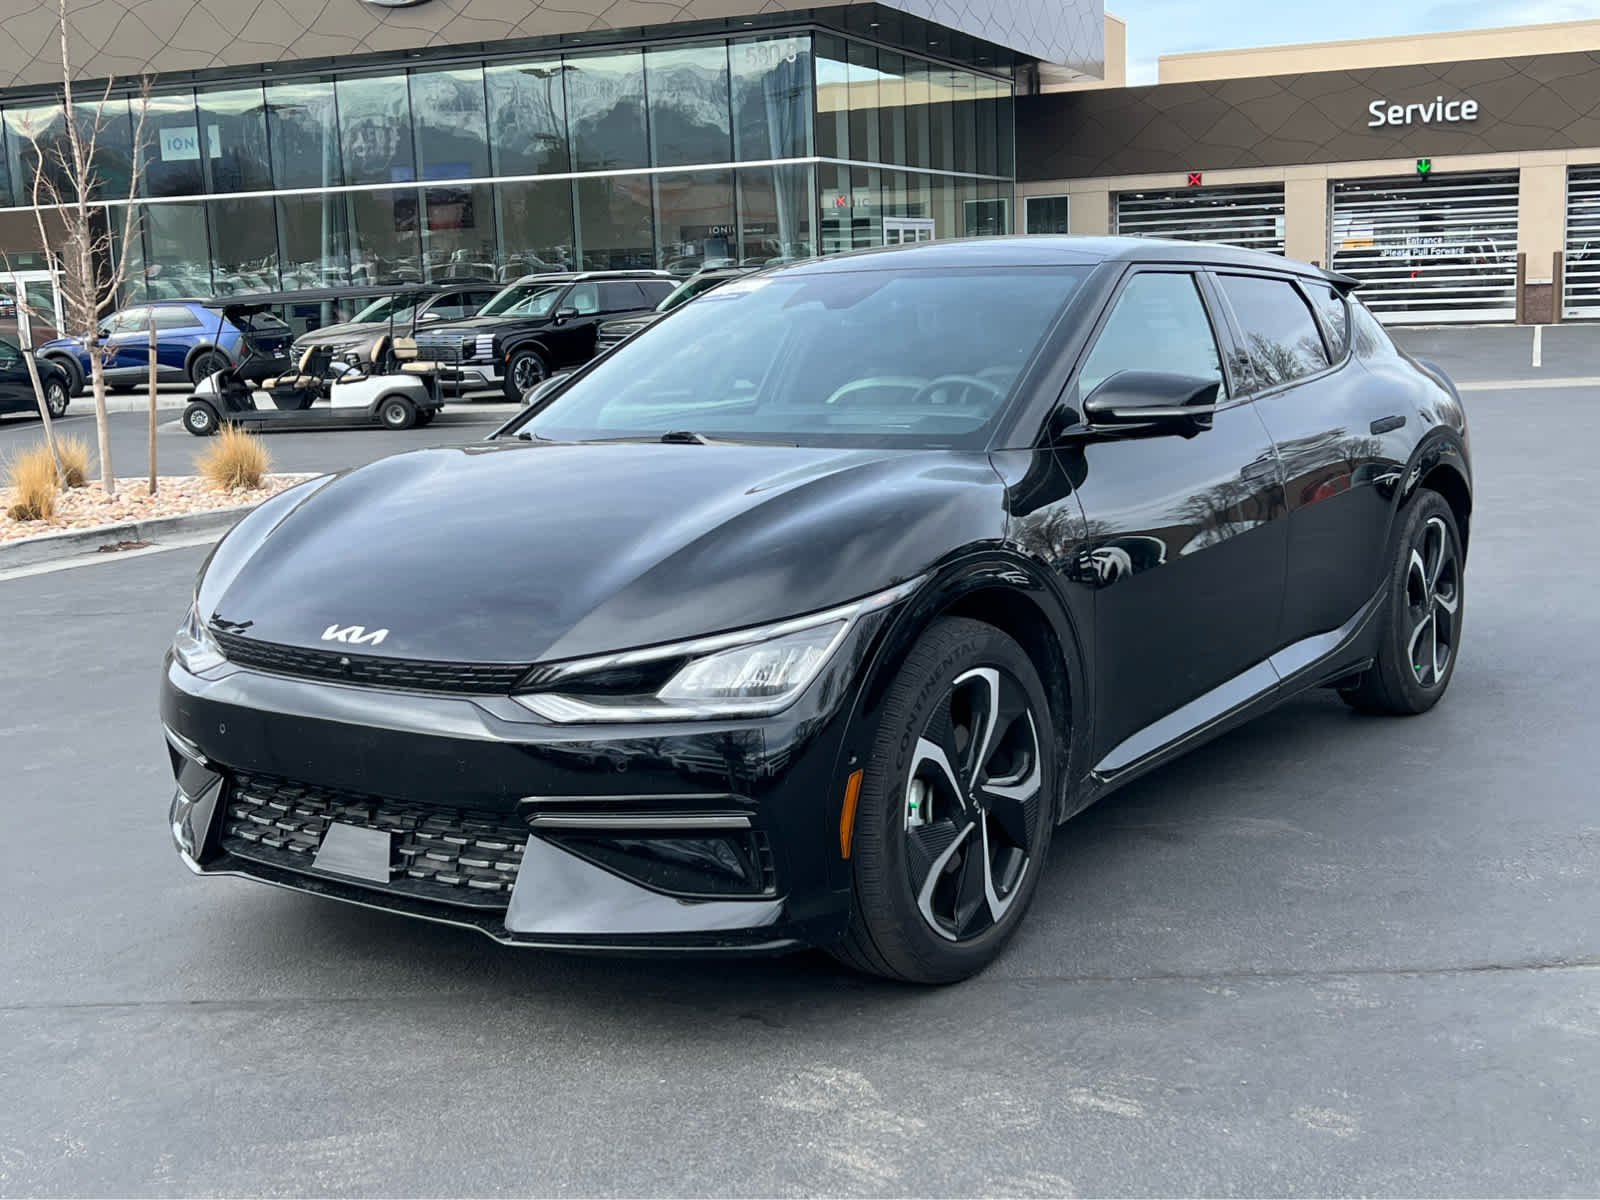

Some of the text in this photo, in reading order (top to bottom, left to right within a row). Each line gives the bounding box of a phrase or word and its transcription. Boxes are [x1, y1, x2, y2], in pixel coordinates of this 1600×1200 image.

[1368, 96, 1478, 127] Service
[167, 136, 212, 151] ION
[1406, 237, 1442, 246] Entrance
[1413, 247, 1428, 256] Pull
[1430, 245, 1465, 255] Forward
[896, 640, 977, 771] CONTINENTAL
